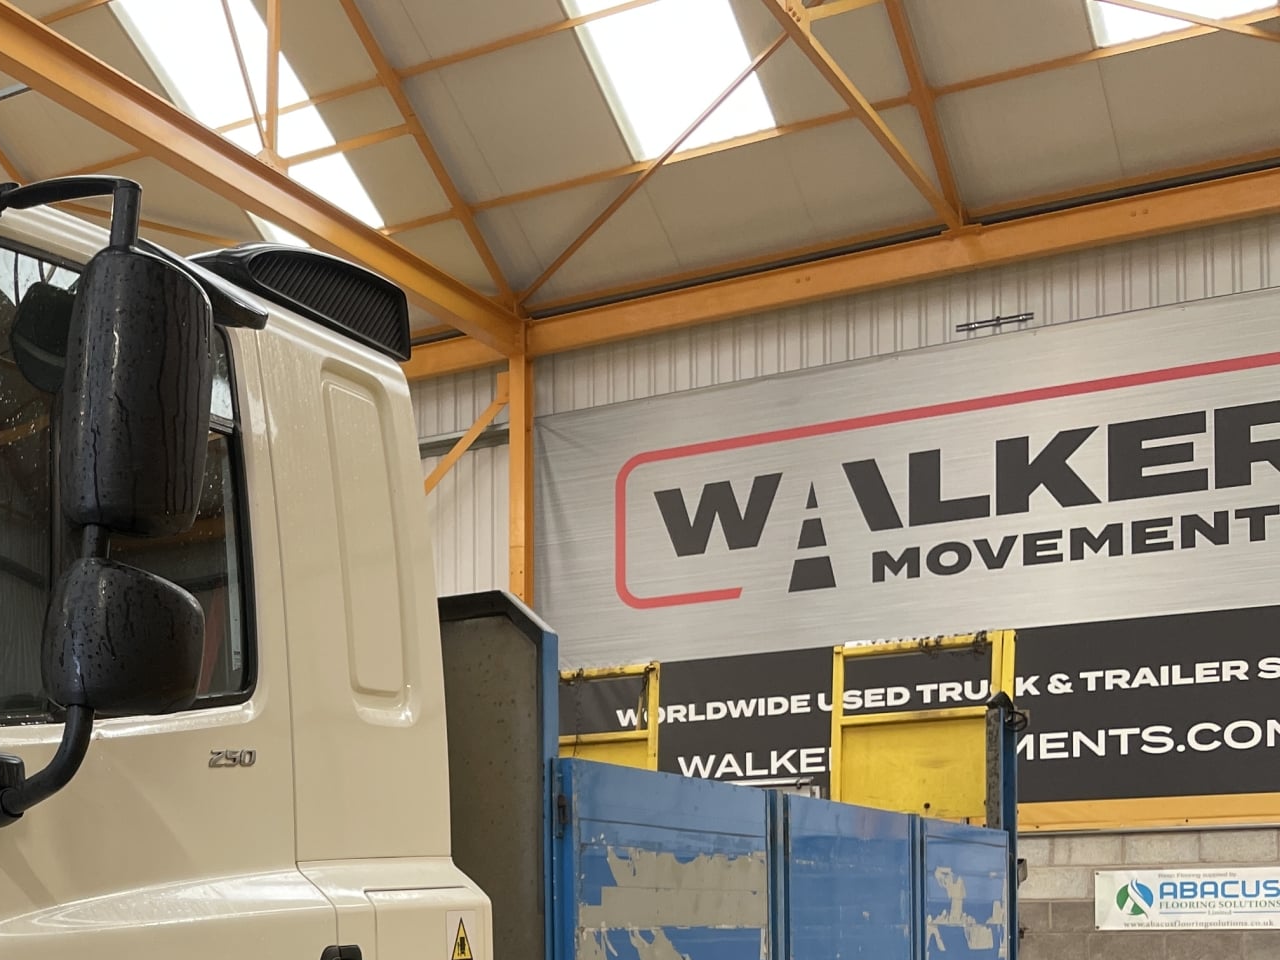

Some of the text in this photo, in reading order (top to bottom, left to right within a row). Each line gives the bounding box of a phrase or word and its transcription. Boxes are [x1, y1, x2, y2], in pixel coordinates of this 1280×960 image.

[654, 400, 1280, 593] WALKER
[916, 675, 1040, 705] TRUK
[1047, 673, 1073, 695] &
[1080, 660, 1249, 692] TRAILER
[209, 749, 256, 768] 250
[1159, 880, 1280, 899] ABACUS
[1159, 901, 1216, 910] FLOORING
